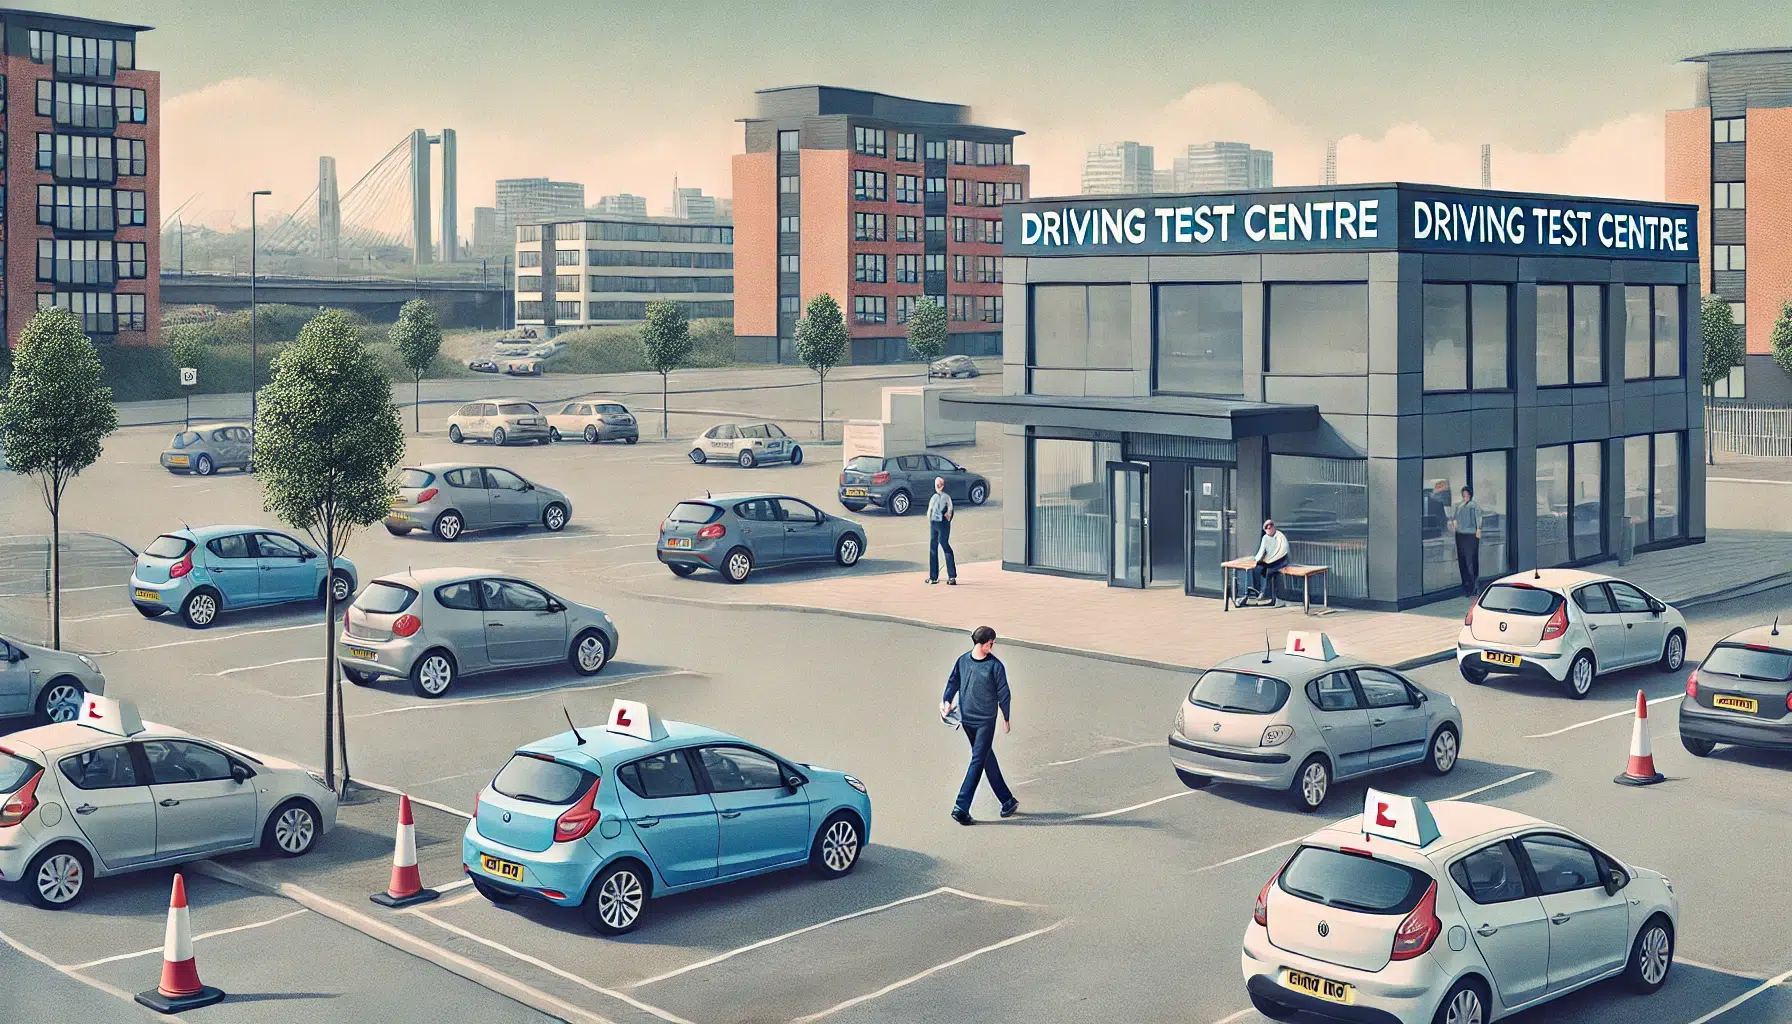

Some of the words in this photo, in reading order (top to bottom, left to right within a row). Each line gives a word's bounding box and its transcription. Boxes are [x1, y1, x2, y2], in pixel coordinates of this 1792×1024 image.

[1021, 208, 1146, 246] DRIVING
[1154, 205, 1235, 244] TEST
[1244, 199, 1379, 242] CENTRE
[1414, 201, 1525, 246] DRIVING
[1532, 207, 1592, 247] TEST
[1597, 212, 1689, 252] CENTRE
[1293, 638, 1305, 652] L
